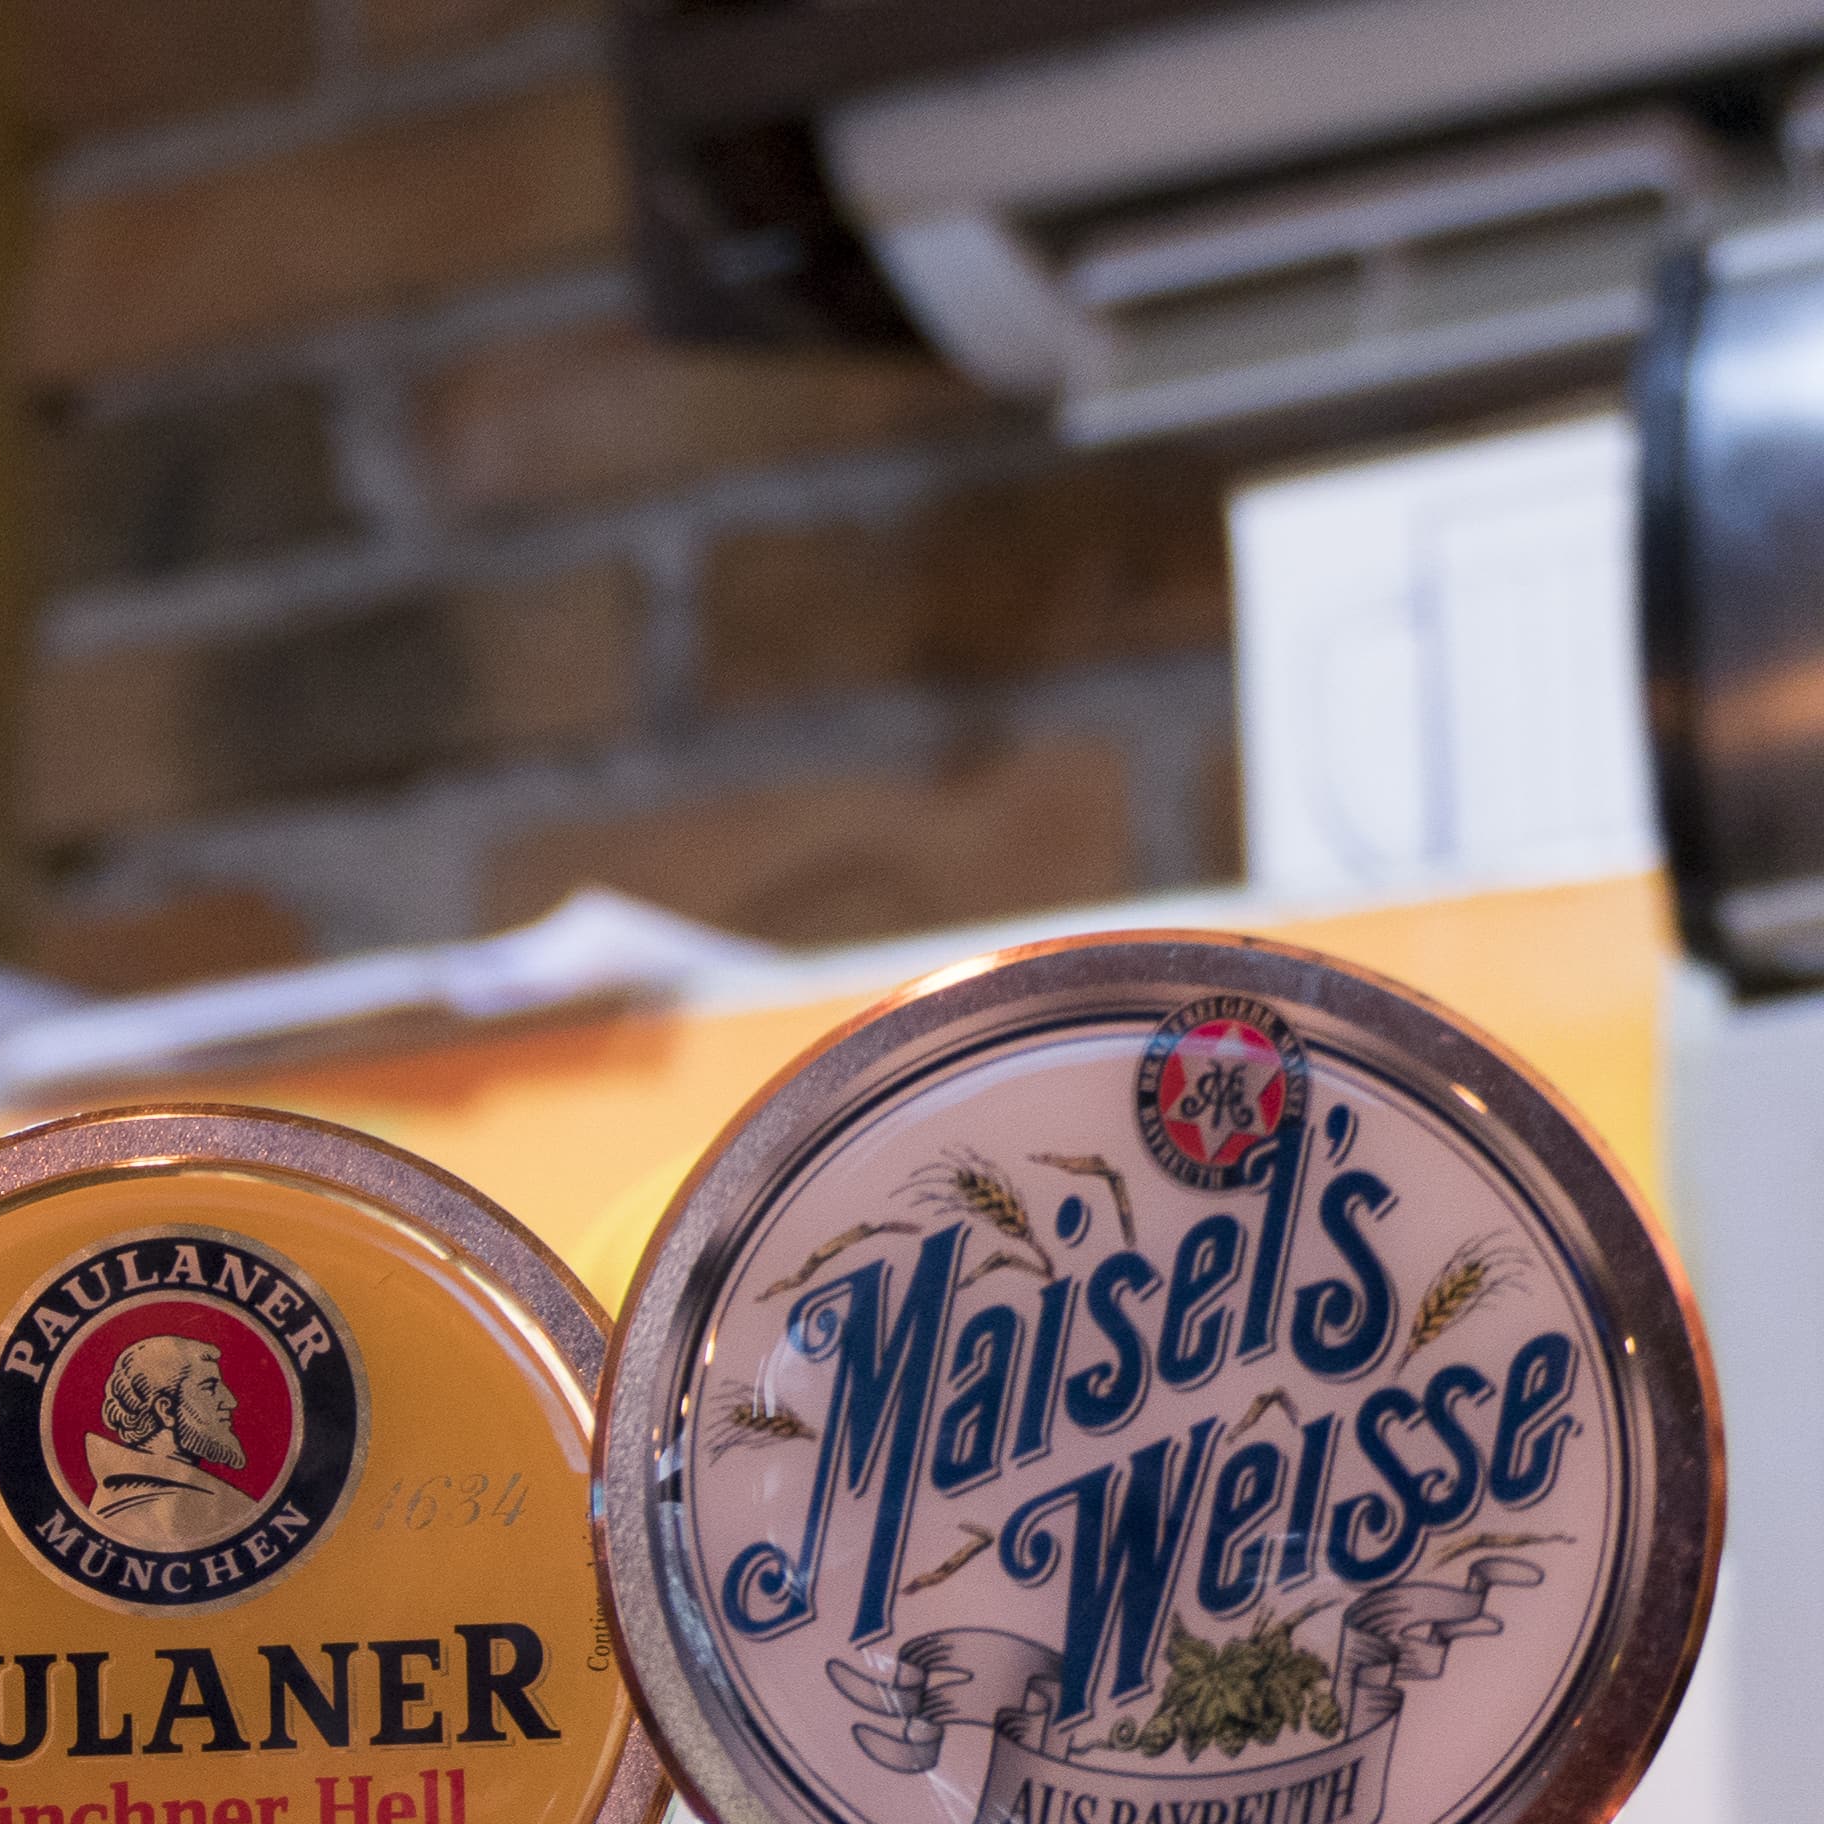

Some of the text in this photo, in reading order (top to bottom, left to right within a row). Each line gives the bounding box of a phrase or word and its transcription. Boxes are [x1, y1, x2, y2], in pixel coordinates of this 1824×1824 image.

[3, 1244, 333, 1383] PAULANER
[723, 1105, 1399, 1650] Maisel's
[35, 1499, 312, 1595] MÜNCHEN
[373, 1471, 530, 1533] 1634
[999, 1330, 1582, 1727] Weisse
